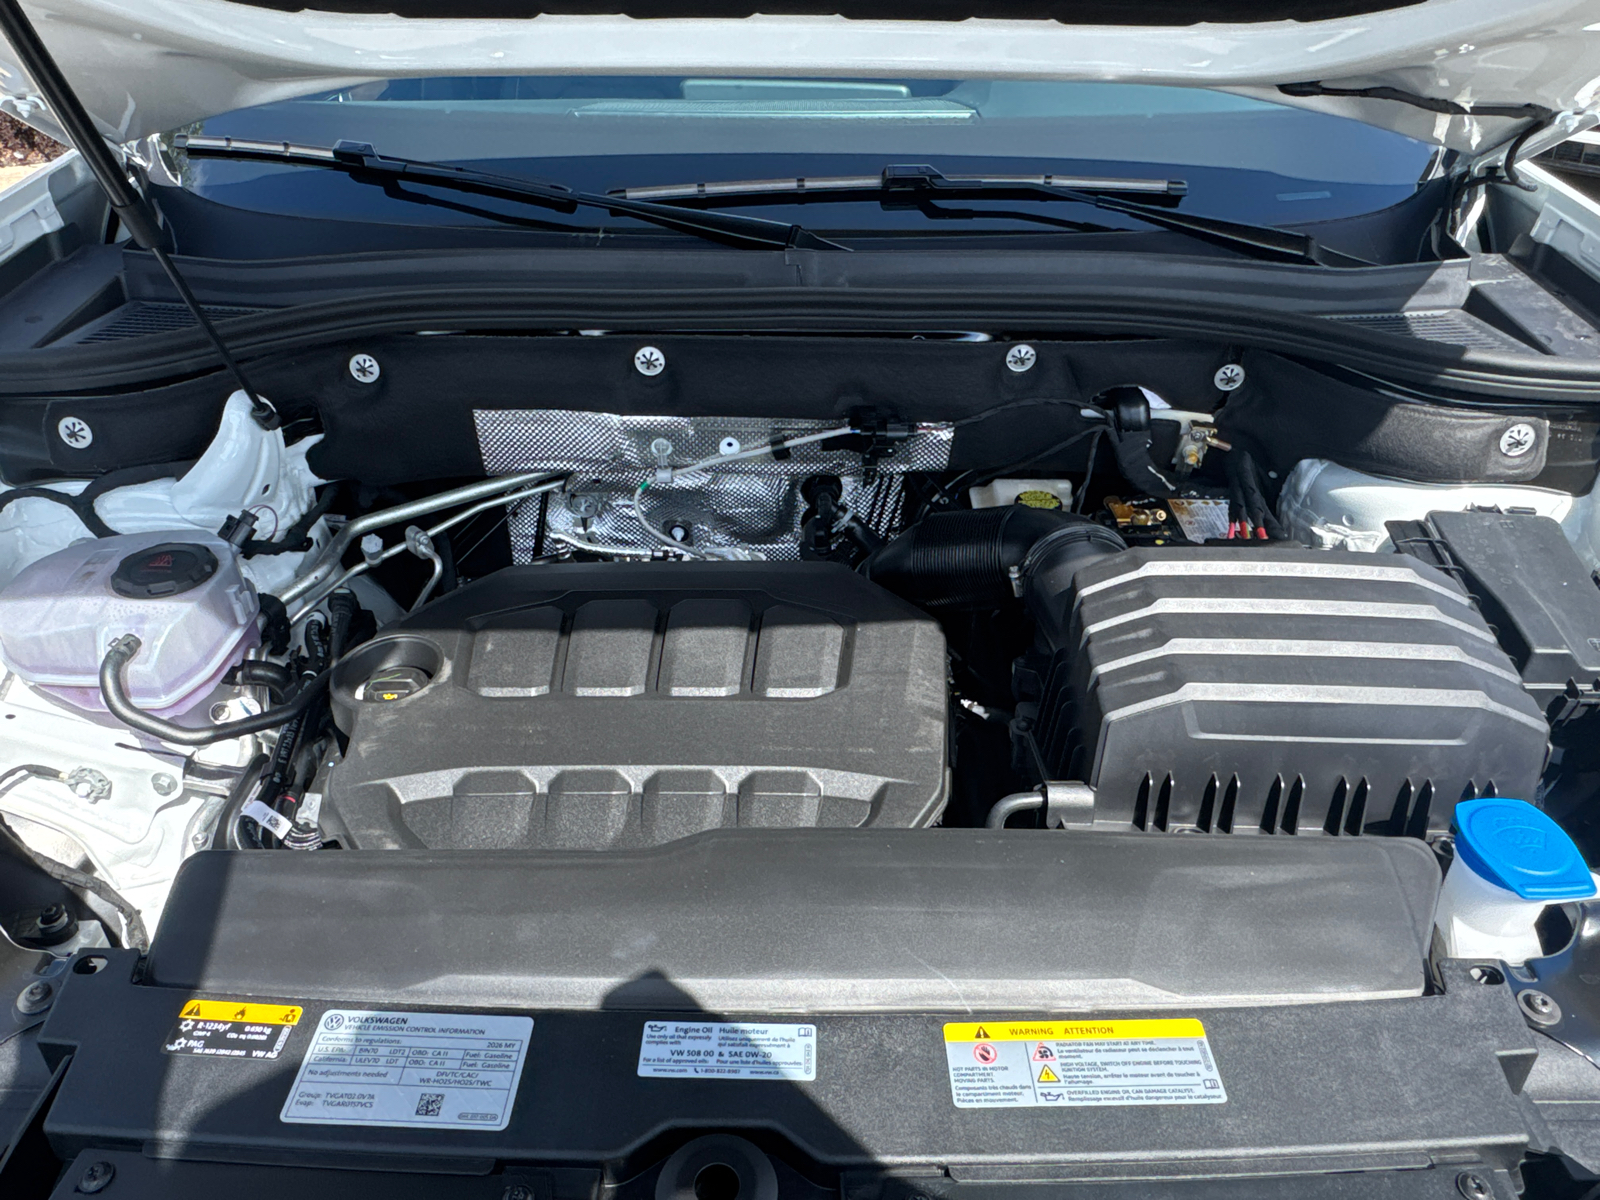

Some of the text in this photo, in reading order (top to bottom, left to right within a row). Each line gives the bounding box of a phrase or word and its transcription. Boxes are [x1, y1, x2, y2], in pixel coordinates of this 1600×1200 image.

[348, 1016, 408, 1024] VOLKSWAGEN
[196, 1022, 272, 1034] R-1234yf kg
[1009, 1026, 1114, 1036] WARNING ATTENTION
